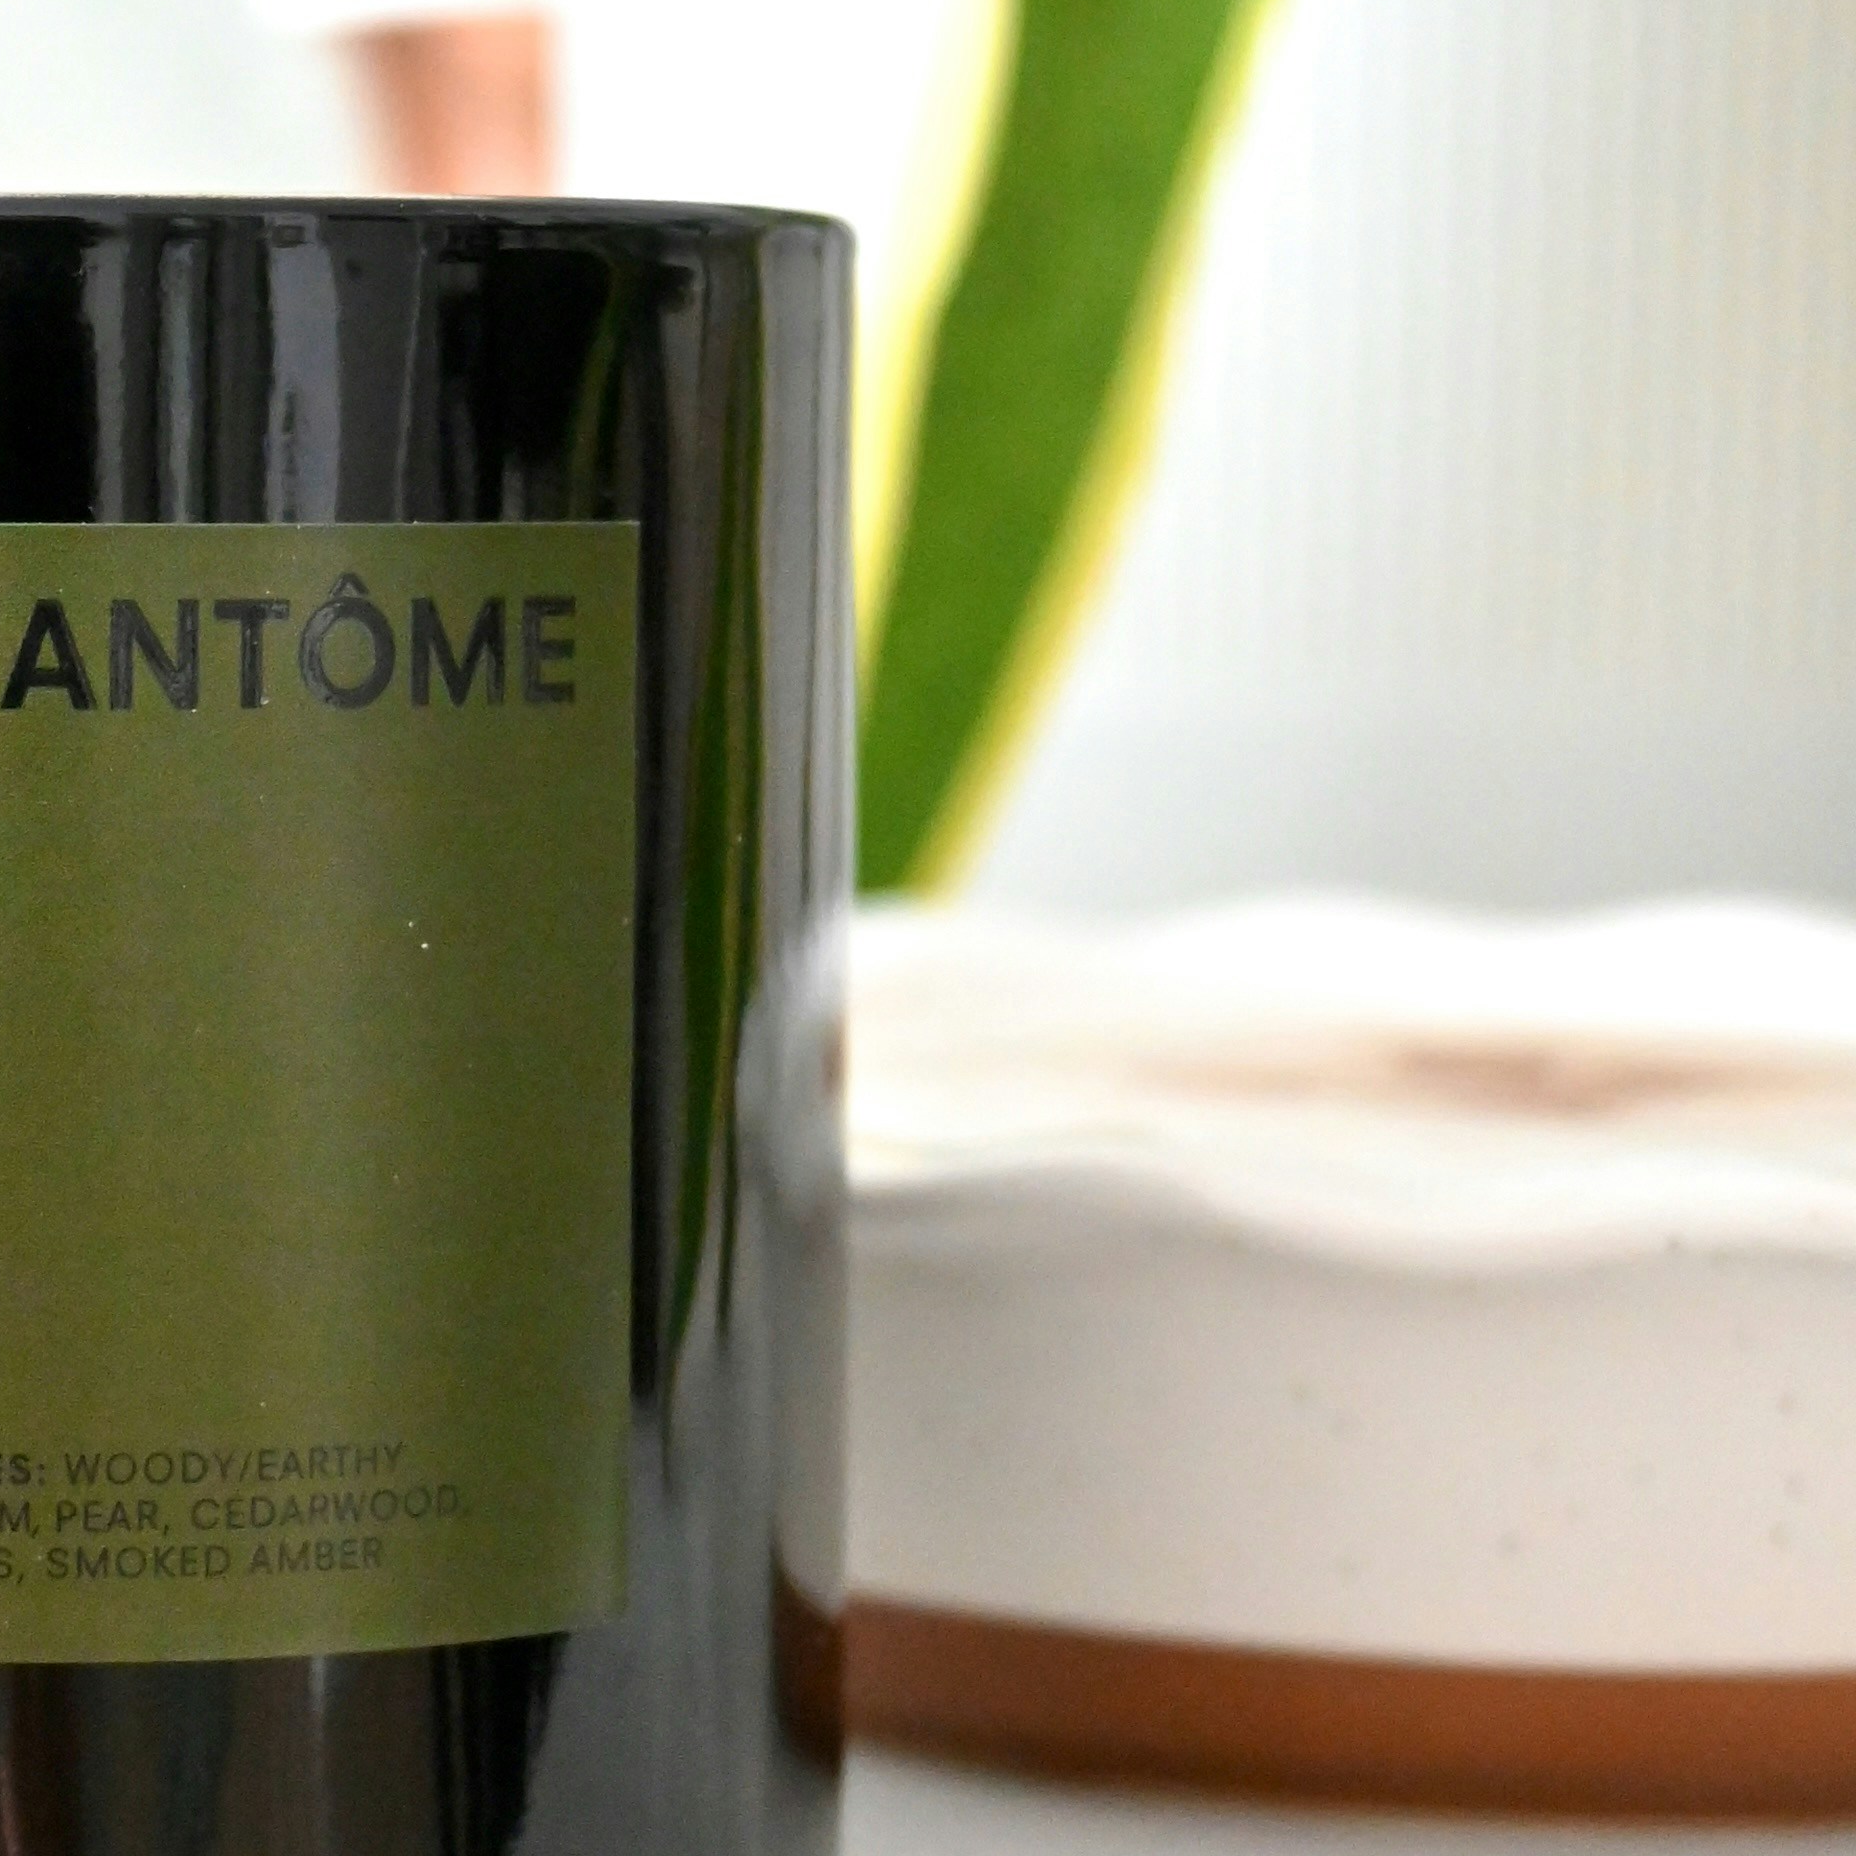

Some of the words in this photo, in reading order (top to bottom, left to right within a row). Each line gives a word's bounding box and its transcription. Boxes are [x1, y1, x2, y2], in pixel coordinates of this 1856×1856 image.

[63, 1442, 404, 1486] WOODY/EARTHY
[55, 1499, 170, 1536] PEAR,
[46, 1544, 232, 1581] SMOKED
[248, 1536, 385, 1574] AMBER
